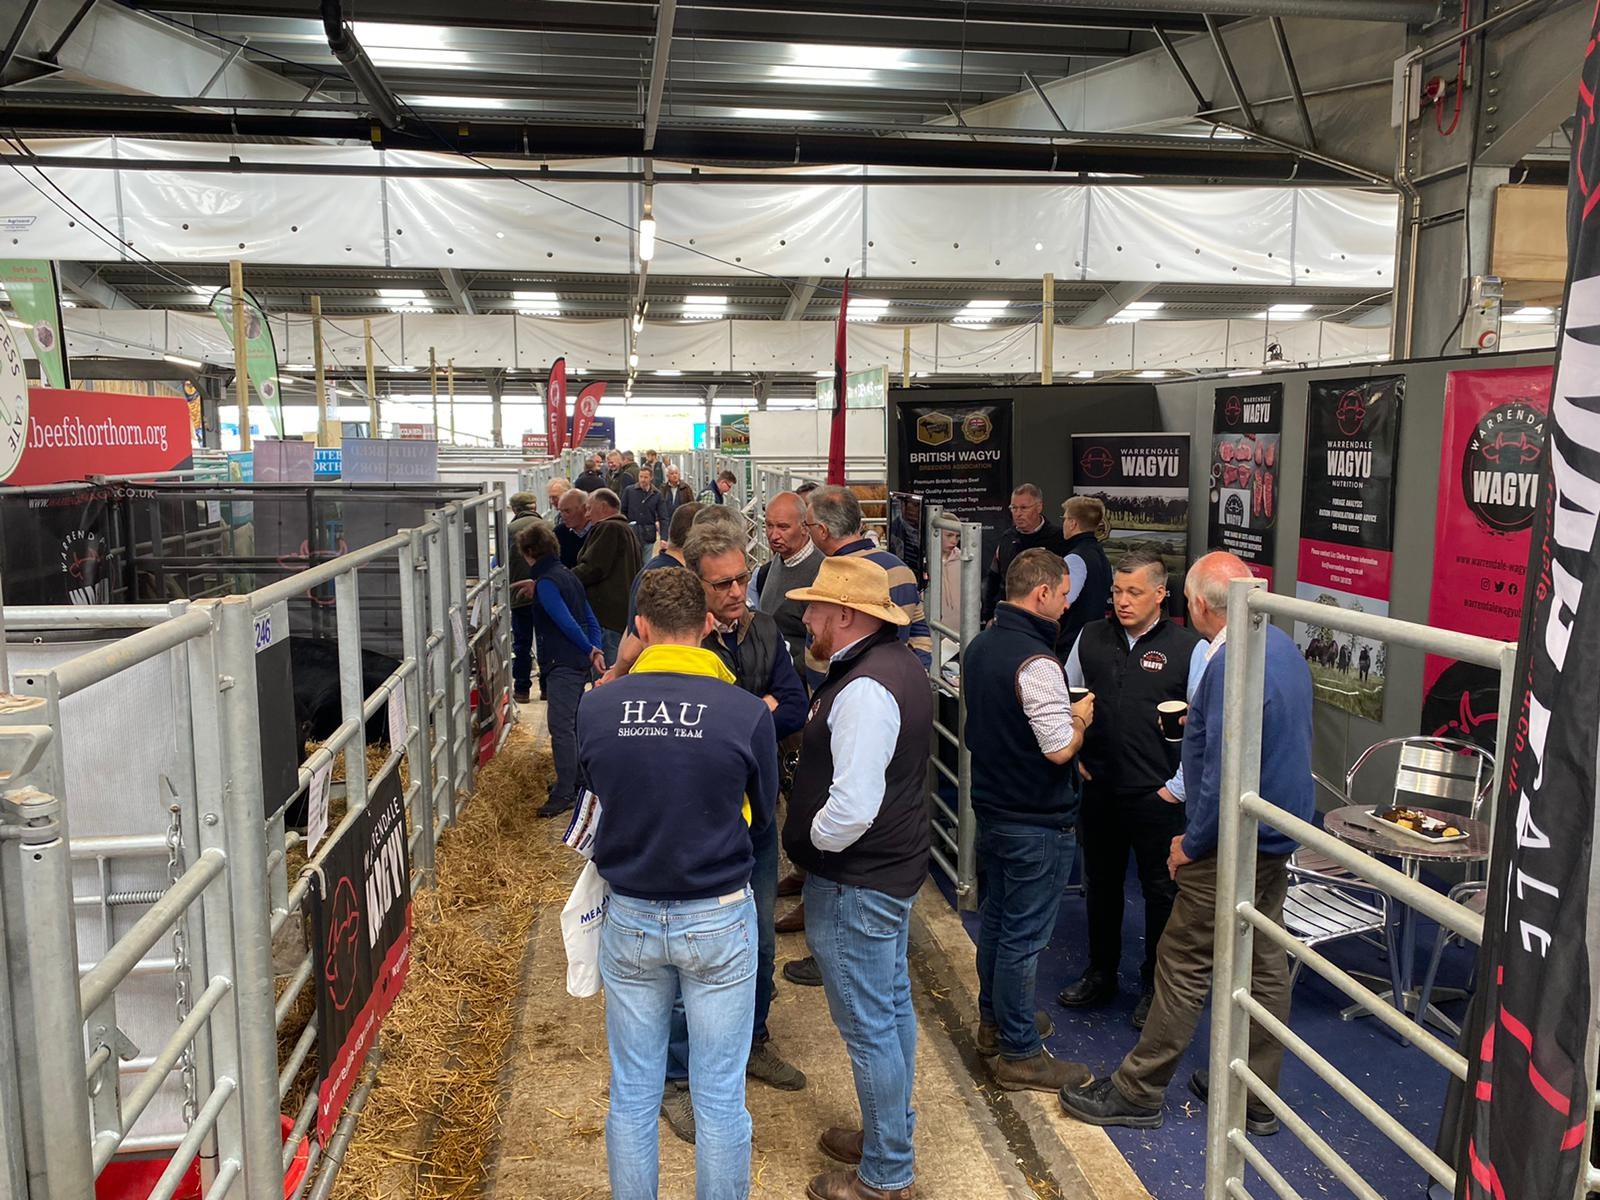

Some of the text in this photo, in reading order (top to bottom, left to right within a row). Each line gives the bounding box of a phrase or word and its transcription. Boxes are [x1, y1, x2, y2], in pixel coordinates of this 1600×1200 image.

[1243, 403, 1271, 424] WAGYU
[1327, 440, 1373, 450] WARRENDALE
[910, 449, 1001, 463] BRITISH WAGYU
[1121, 456, 1179, 477] WAGYU
[1327, 450, 1372, 479] WAGYU
[1332, 480, 1364, 489] NUTRITION
[59, 530, 114, 573] WARRENDE
[255, 617, 272, 648] 246
[620, 700, 708, 726] HAU
[618, 727, 703, 739] SHOOTING TEAM
[364, 796, 401, 875] WRENDALE
